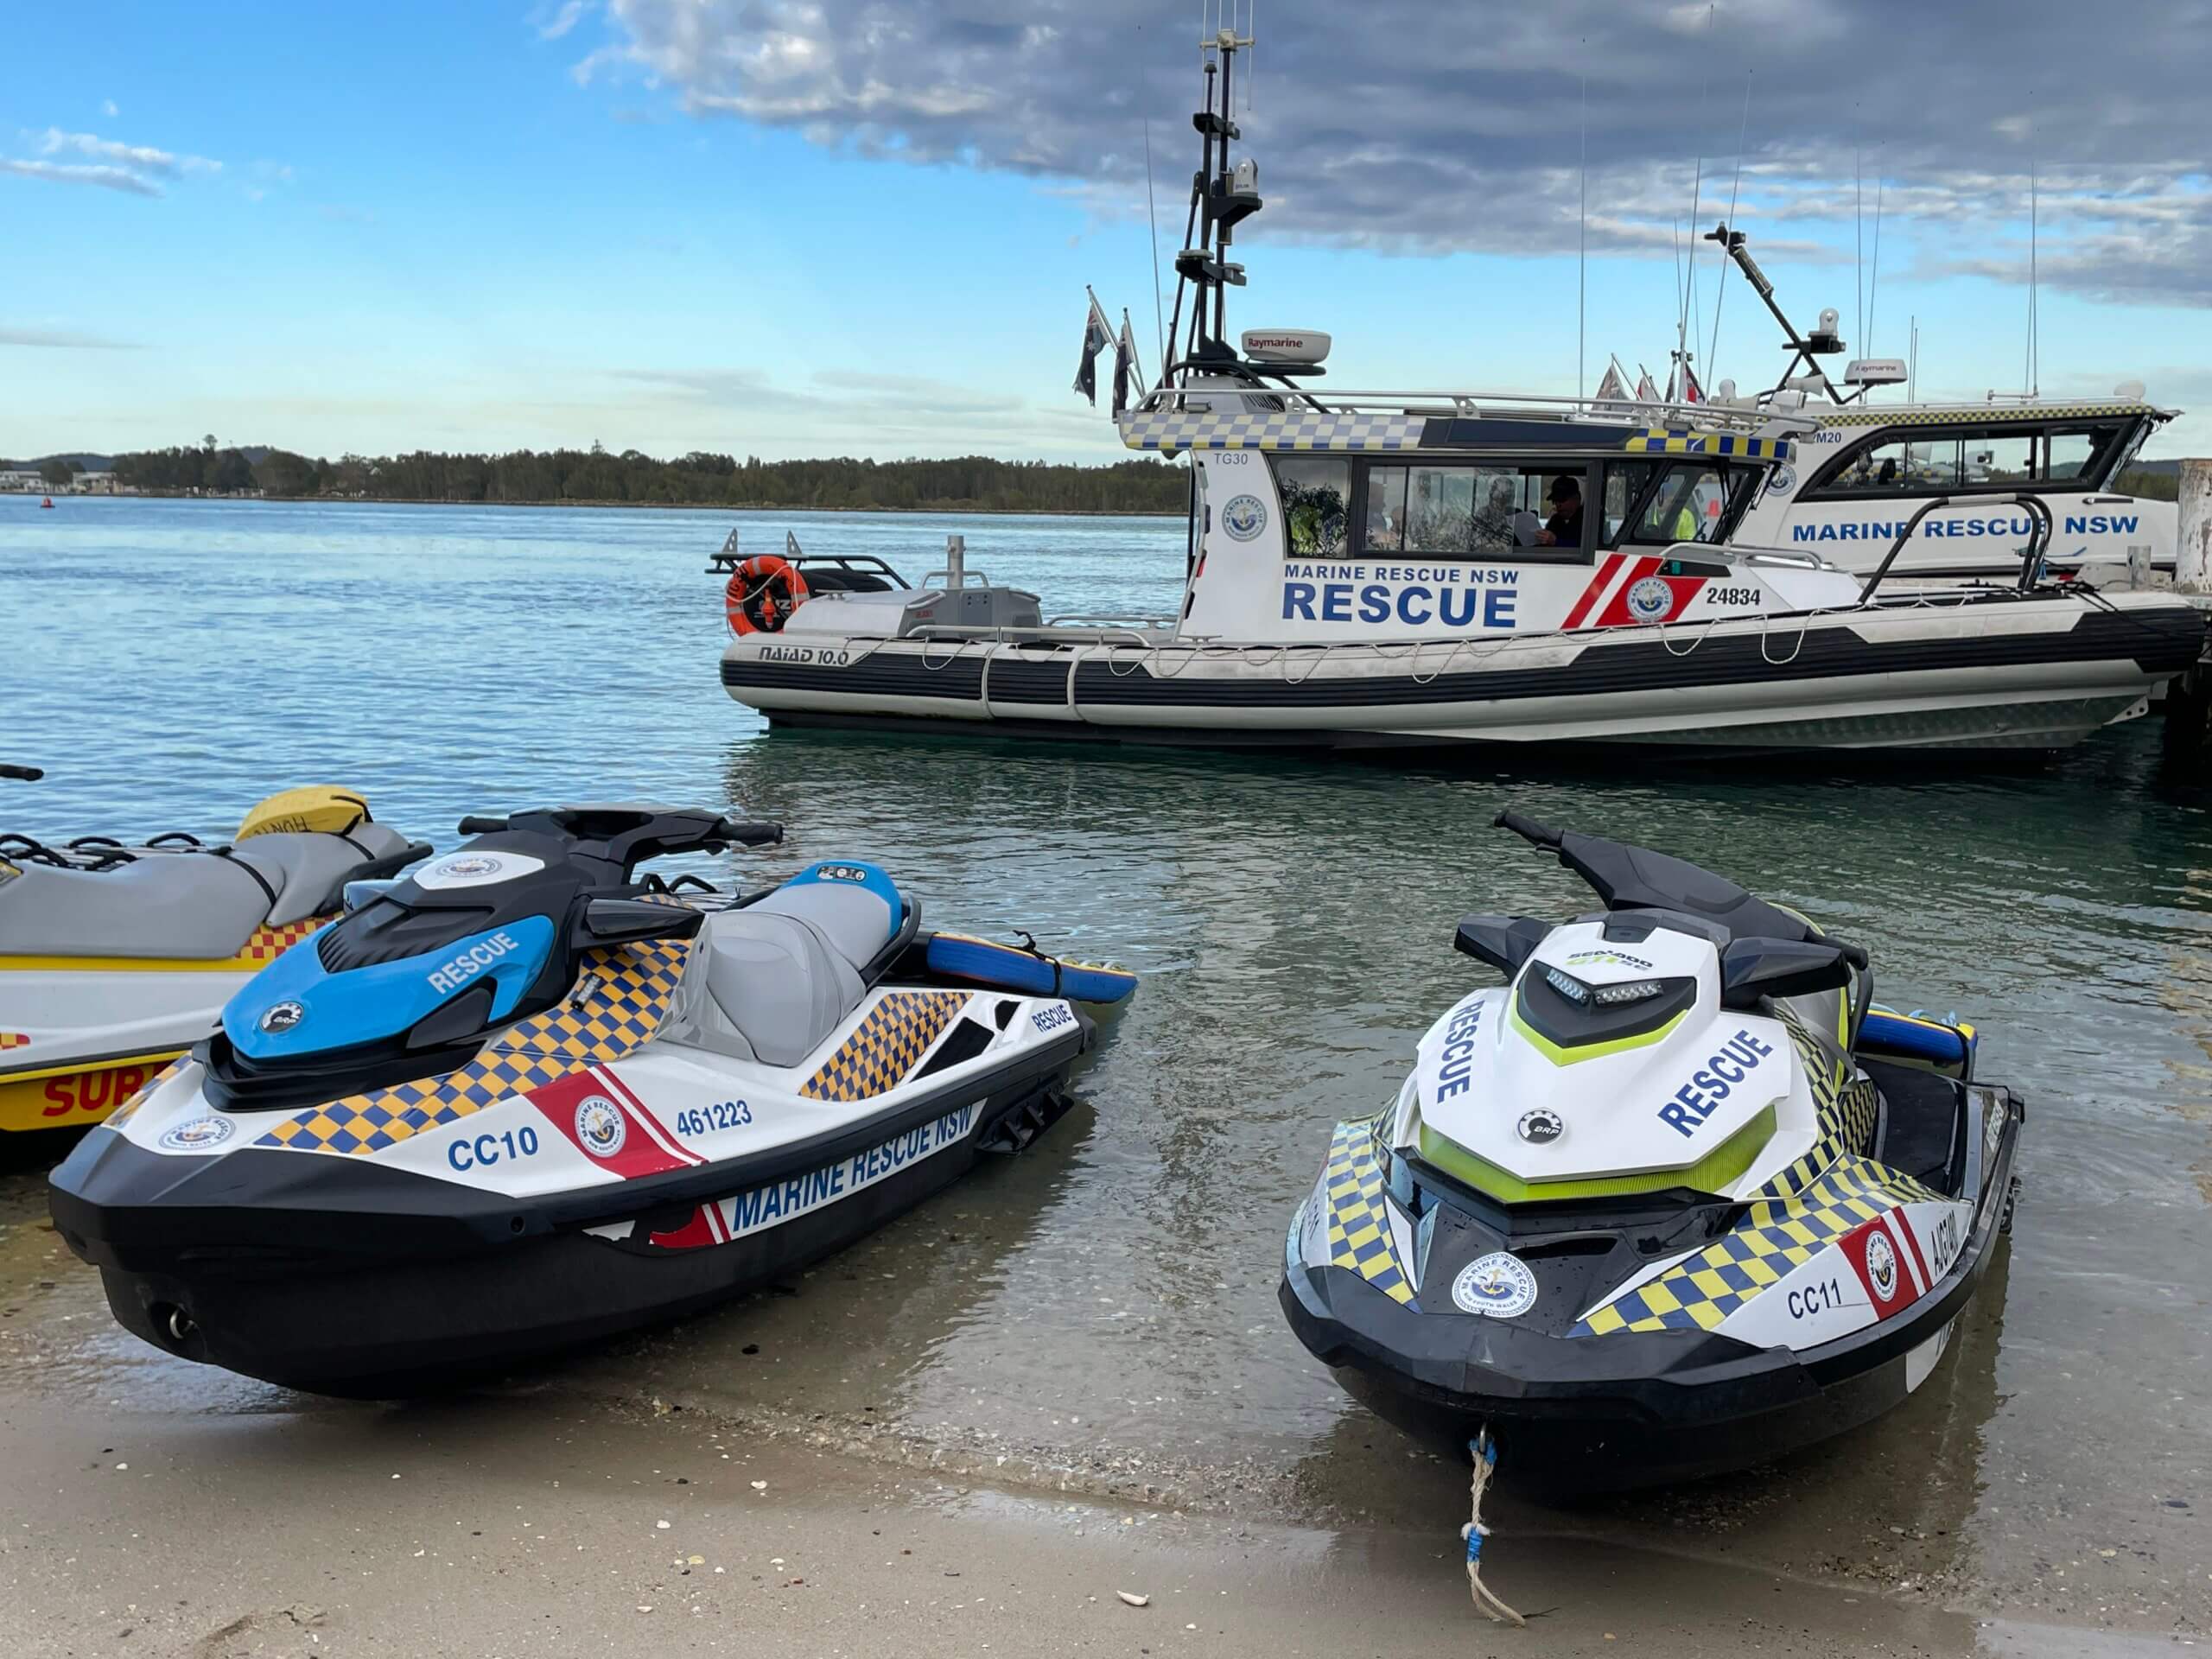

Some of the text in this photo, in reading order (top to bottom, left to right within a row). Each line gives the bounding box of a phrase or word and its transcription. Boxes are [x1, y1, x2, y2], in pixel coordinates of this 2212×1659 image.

[1248, 338, 1303, 349] Raymarine
[1814, 433, 1841, 443] M20
[1214, 453, 1248, 465] TG30
[2064, 516, 2139, 534] NSW
[1285, 564, 1519, 584] MARINE RESCUE NSW
[1282, 582, 1518, 628] RESCUE
[1707, 588, 1761, 606] 24834
[817, 650, 849, 665] 10.0
[427, 932, 519, 995] RESCUE
[1031, 1004, 1072, 1033] RESCUE
[1437, 1000, 1485, 1103] RESCUE
[41, 1061, 175, 1117] SUR
[1657, 1029, 1774, 1138] RESCUE
[581, 1102, 620, 1138] MARINE RESCUE
[677, 1100, 753, 1136] 461223
[1534, 1126, 1560, 1135] BRP
[448, 1127, 538, 1172] CC10
[733, 1105, 973, 1232] MARINE RESCUE NSW
[1461, 1260, 1527, 1300] MARINE RESCUE
[1788, 1279, 1841, 1319] CC11
